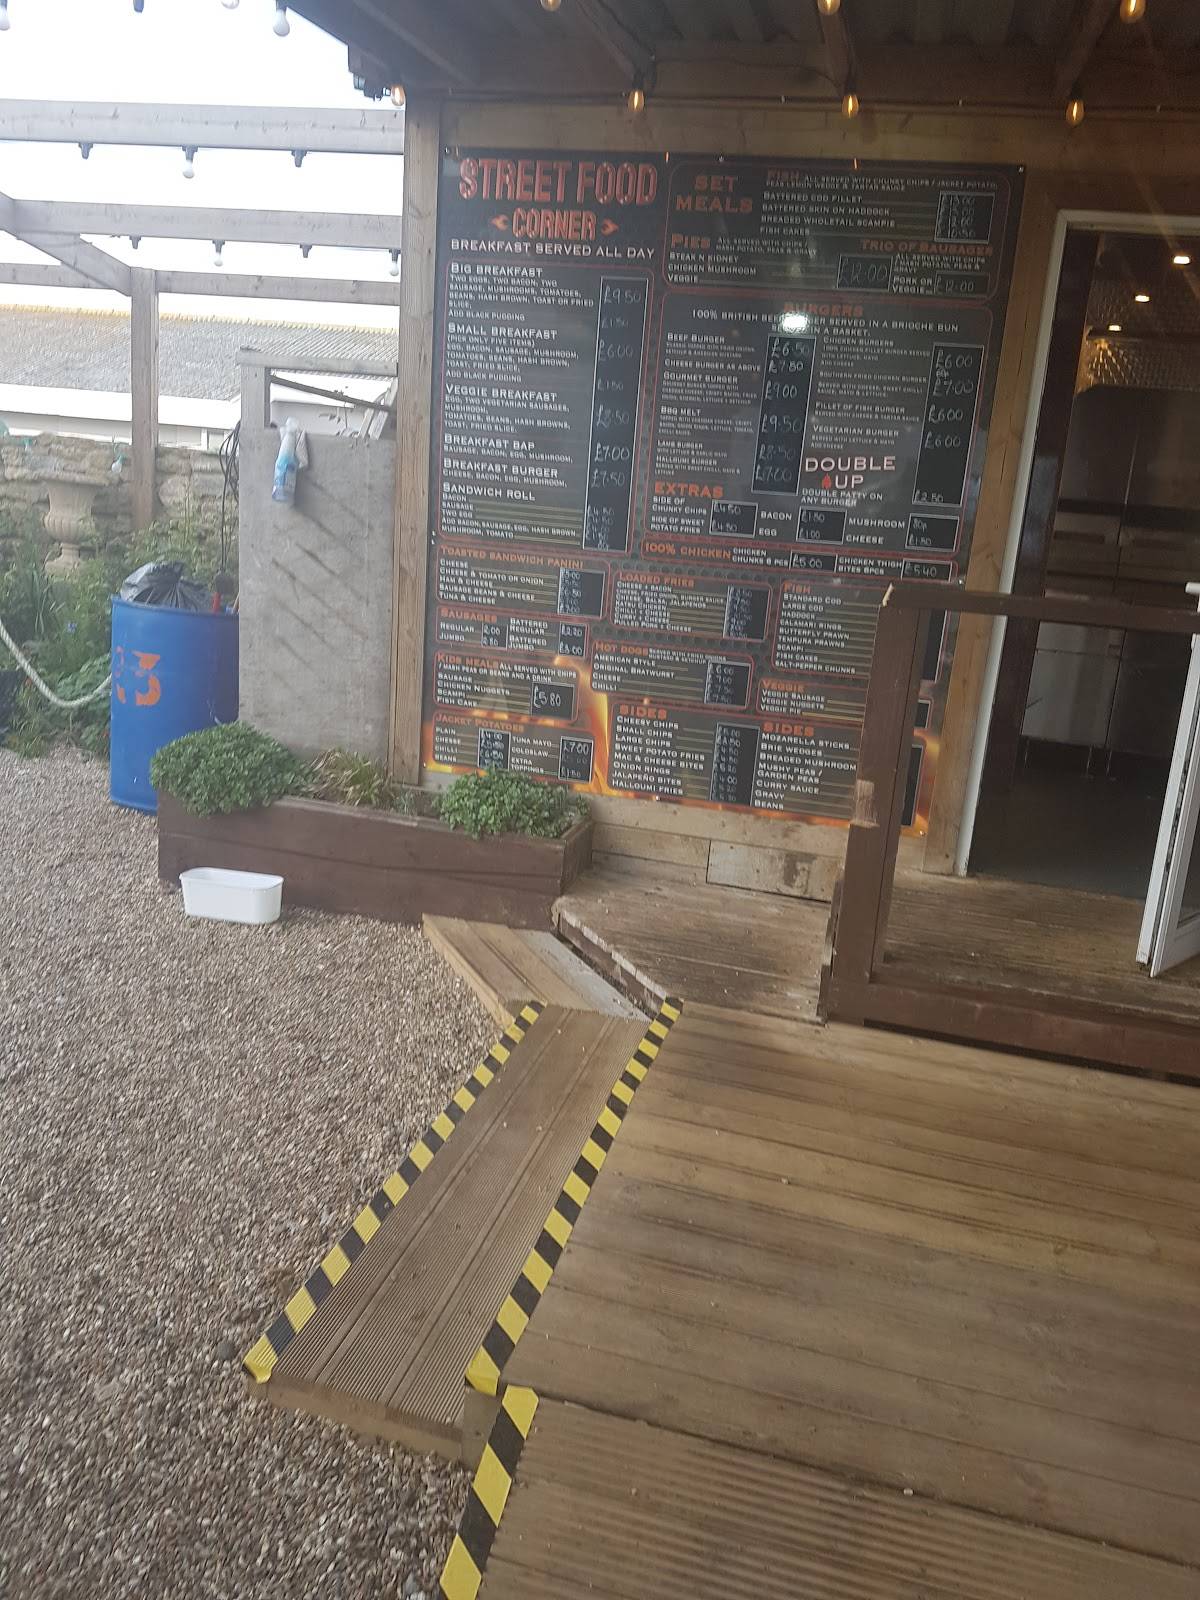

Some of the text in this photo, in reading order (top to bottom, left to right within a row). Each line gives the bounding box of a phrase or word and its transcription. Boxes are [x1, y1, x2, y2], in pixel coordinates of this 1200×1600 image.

[459, 157, 658, 206] STREET FOOD
[693, 175, 738, 193] SET
[676, 195, 753, 214] MEALS
[512, 208, 597, 240] CORNER
[451, 239, 656, 257] BREAKFAST SERVED ALL DAY
[671, 233, 711, 249] PIES
[451, 263, 544, 278] BIG BREAKFAST
[692, 309, 718, 320] 100%
[892, 319, 934, 330] BRIOCHE
[937, 321, 960, 332] BUN
[449, 323, 558, 340] SMALL BREAKFAST
[667, 332, 726, 344] BEEF BURGER
[664, 371, 738, 385] GOURMET BURGER
[445, 384, 558, 403] VEGGIE BREAKFAST
[680, 407, 702, 417] MELT
[813, 424, 900, 438] VEGETARIAN BURGER
[445, 433, 536, 452] BREAKFAST BAP
[444, 457, 558, 479] BREAKFAST BURGER
[805, 455, 896, 472] DOUBLE
[835, 474, 864, 489] UP
[443, 481, 536, 503] SANDWICH ROLL
[655, 481, 724, 500] EXTRAS
[802, 488, 884, 501] DOUBLE PATTY ON
[652, 495, 686, 506] SIDE OF
[801, 495, 818, 505] ANY
[652, 504, 708, 516] CHUNKY CHIPS
[761, 510, 792, 522] BACON
[849, 517, 906, 529] MUSHROOM
[759, 528, 778, 536] EGG
[846, 534, 886, 544] CHEESE
[441, 545, 584, 570] TOASTED SANDWICH PANINI
[645, 542, 732, 560] 100% CHICKEN
[619, 571, 694, 588] LOADED FRIES
[783, 580, 812, 594] FISH
[784, 592, 842, 606] STANDARD COD
[441, 608, 498, 623] SAUSAGES
[441, 621, 474, 634] REGULAR
[779, 627, 850, 641] BUTTERFLY PRAWN
[440, 632, 464, 643] JUMBO
[595, 642, 648, 656] HOT DOGS
[437, 654, 462, 666] KIDS
[594, 653, 656, 667] AMERICAN STYLE
[593, 663, 676, 679] ORIGINAL BRATWURST
[437, 680, 510, 696] CHICKEN NUGGETS
[619, 704, 668, 720] SIDES
[436, 713, 524, 733] JACKET POTATOES
[617, 715, 679, 731] CHEESY CHIPS
[763, 721, 814, 737] SIDES
[616, 724, 673, 739] SMALL CHIPS
[512, 736, 552, 748] TUNA MAYO
[616, 734, 671, 748] LARGE CHIPS
[762, 732, 850, 751] MOZARELLA STICKS
[615, 743, 705, 762] SWEET POTATO FRIES
[761, 742, 824, 758] BRIE WEDGES
[613, 761, 671, 776] ONION RINGS
[760, 751, 858, 772] BREADED MUSHROOM
[757, 768, 820, 784] GARDEN PEAS
[755, 789, 785, 801] GRAVY
[757, 779, 820, 796] CURRY SAUCE
[755, 799, 784, 811] BEANS
